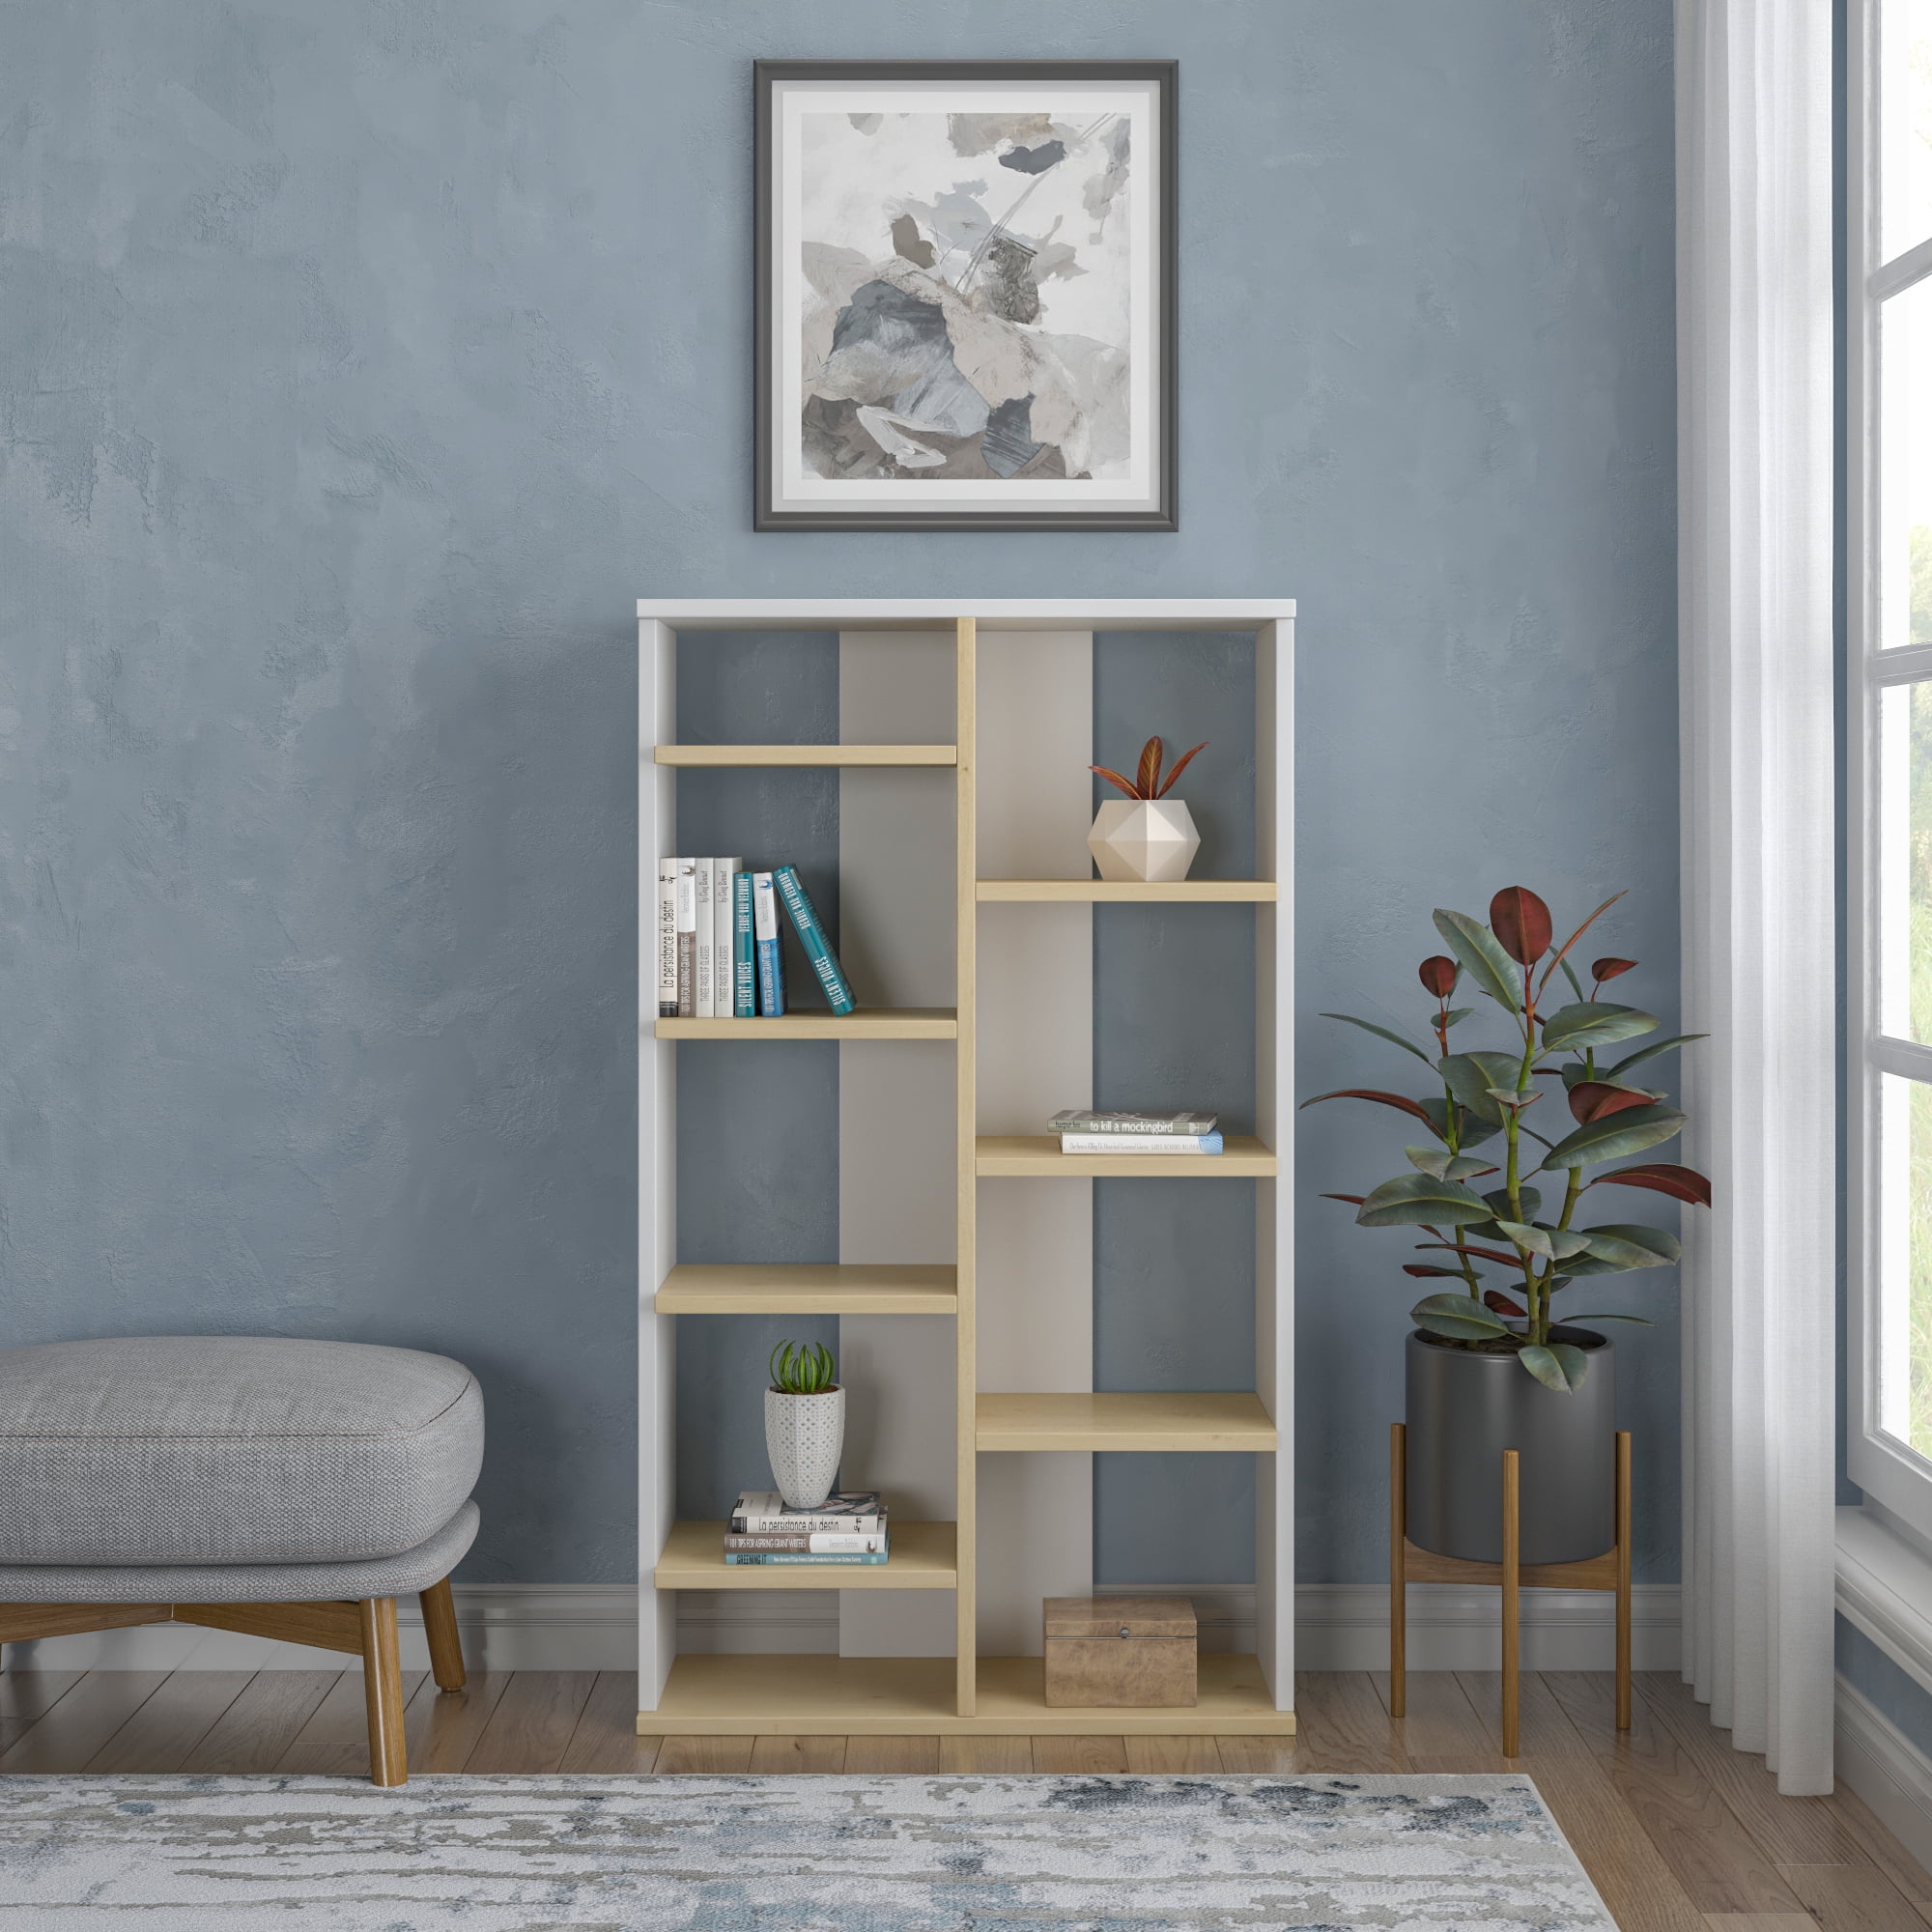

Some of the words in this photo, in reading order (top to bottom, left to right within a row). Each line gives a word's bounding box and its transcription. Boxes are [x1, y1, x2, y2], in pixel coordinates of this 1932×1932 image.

[659, 923, 674, 933] du
[699, 946, 710, 966] GLASSES
[719, 946, 729, 966] GLASSES
[737, 961, 752, 984] VOICES
[814, 955, 836, 982] VOICES
[699, 973, 710, 987] PAIRS
[719, 973, 729, 987] PAIRS
[699, 987, 710, 1002] THREE
[719, 987, 729, 1002] THREE
[737, 986, 752, 1008] SILENT
[825, 980, 846, 1006] SILENT
[1090, 1122, 1098, 1132] to
[1101, 1121, 1112, 1131] kill
[1114, 1123, 1120, 1132] a
[1122, 1121, 1174, 1134] mockingbird
[758, 1517, 767, 1531] La
[769, 1517, 807, 1534] persistance
[809, 1517, 817, 1531] du
[819, 1517, 839, 1531] destin
[737, 1538, 747, 1548] TIPS
[747, 1538, 755, 1548] FOR
[774, 1538, 788, 1548] GRANT
[736, 1554, 761, 1565] GREENING
[761, 1554, 767, 1565] IT
